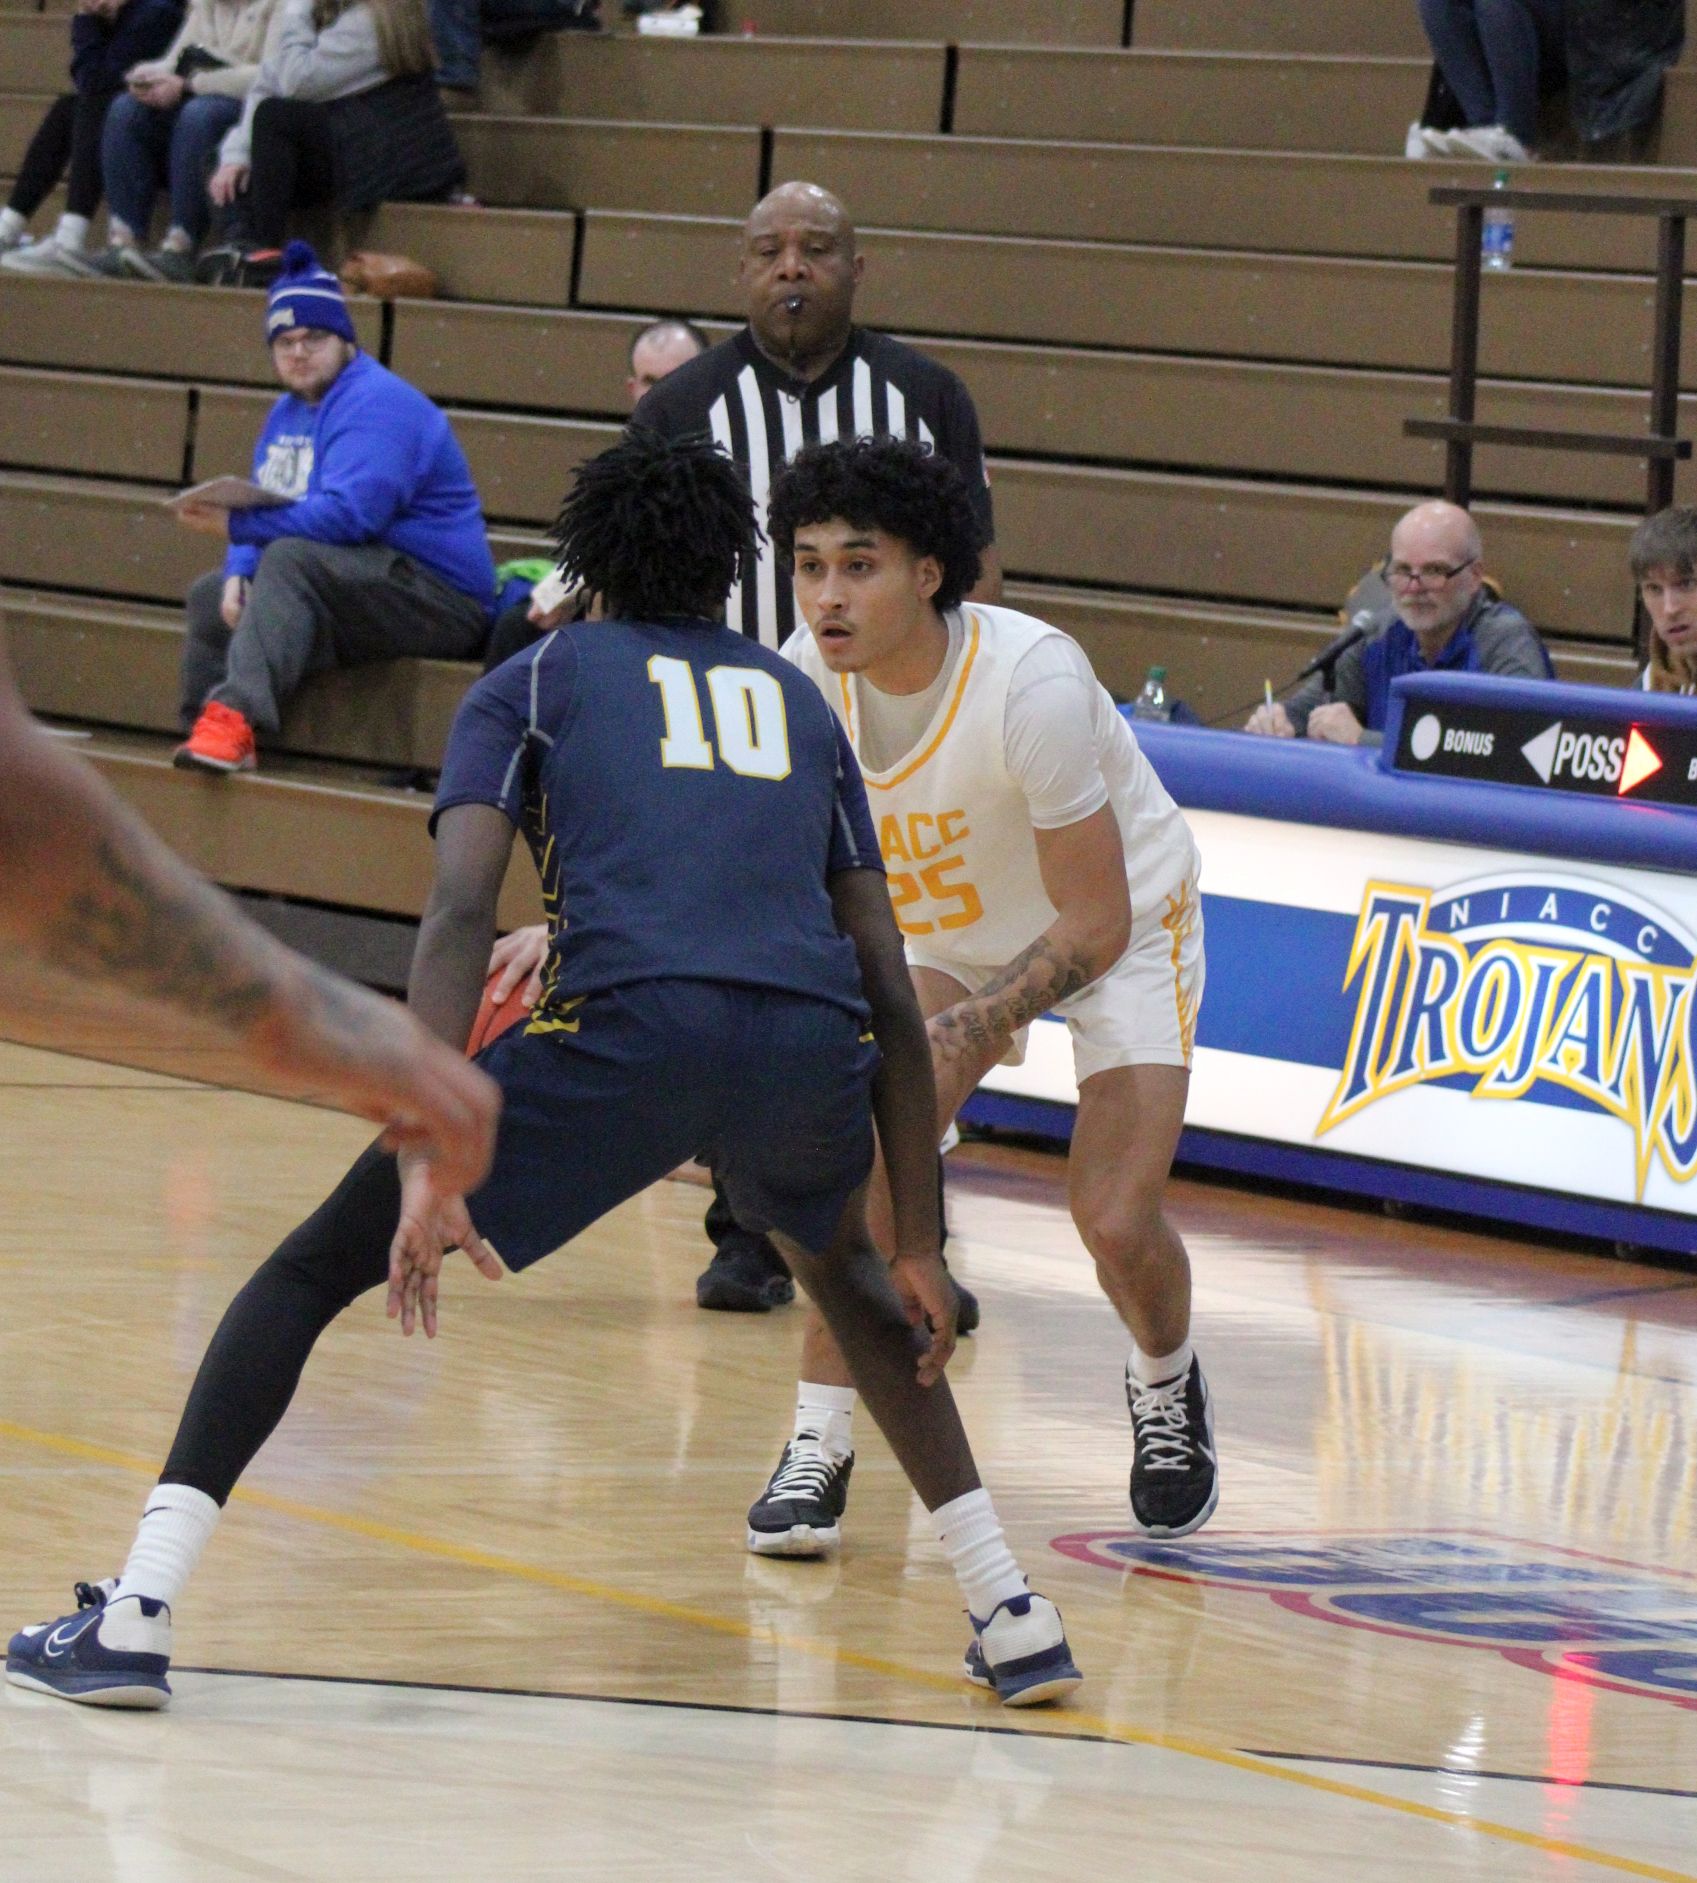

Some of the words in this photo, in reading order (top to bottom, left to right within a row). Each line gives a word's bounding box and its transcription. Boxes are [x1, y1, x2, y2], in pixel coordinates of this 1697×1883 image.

[647, 654, 792, 782] 10
[1443, 728, 1495, 756] BONUS
[1553, 732, 1627, 782] POSS
[880, 809, 971, 862] ACC
[886, 854, 984, 935] 25
[1450, 892, 1658, 953] NIACC
